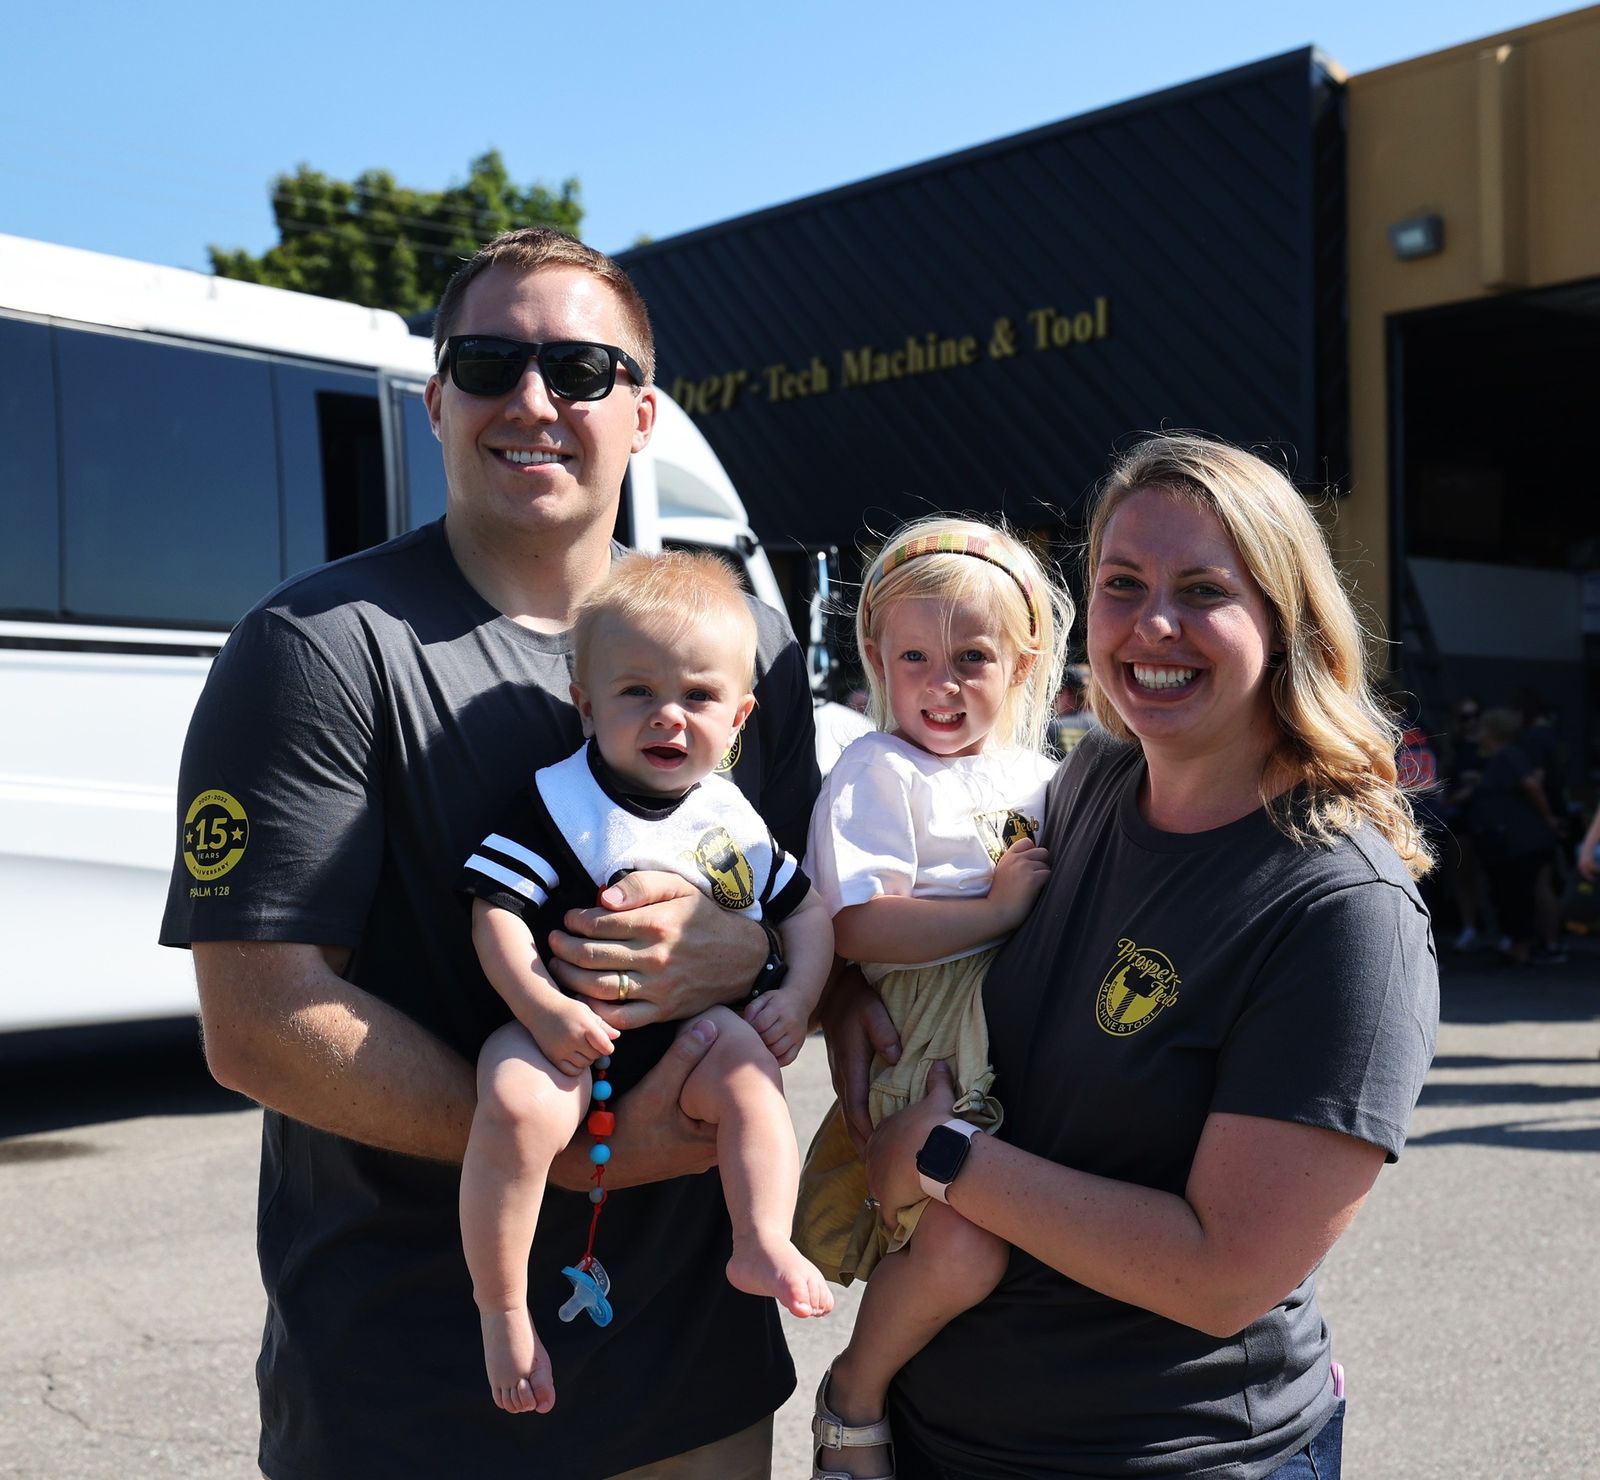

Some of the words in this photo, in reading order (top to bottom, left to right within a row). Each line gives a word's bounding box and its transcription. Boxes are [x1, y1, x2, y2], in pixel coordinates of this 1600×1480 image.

[841, 332, 978, 388] Machine
[988, 317, 1017, 359] &
[1026, 295, 1108, 351] Tool
[195, 817, 228, 850] 15
[196, 852, 220, 860] YEARS
[213, 885, 230, 897] 128
[712, 883, 752, 908] MACHINE
[1099, 982, 1117, 1031] MACHINE
[1117, 1023, 1126, 1033] &
[1127, 1010, 1159, 1032] TOOL
[1147, 980, 1180, 1008] Tech
